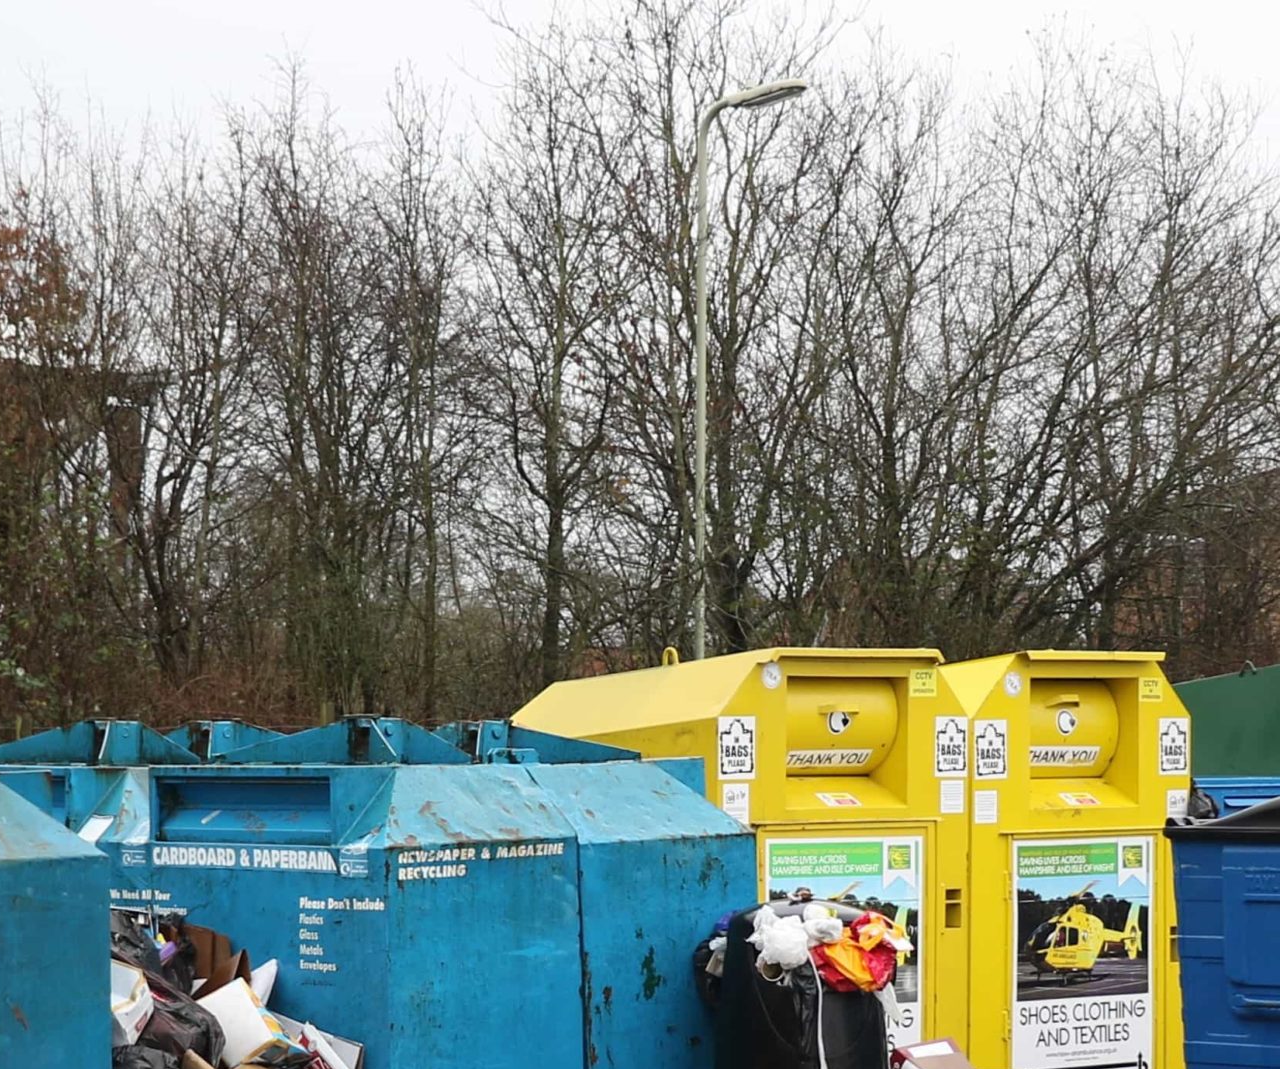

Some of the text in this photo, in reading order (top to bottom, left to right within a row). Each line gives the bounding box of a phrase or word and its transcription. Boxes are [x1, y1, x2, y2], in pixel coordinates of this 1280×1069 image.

[915, 671, 932, 680] CCTV
[725, 745, 749, 758] BAGS
[941, 744, 962, 757] BAGS
[980, 748, 1002, 760] BAGS
[1070, 750, 1097, 762] YOU
[1164, 745, 1183, 757] BAGS
[727, 758, 746, 767] PLEASE
[787, 752, 870, 766] THANK YOU
[942, 757, 960, 765] PLEASE
[982, 760, 999, 769] PLEASE
[1166, 757, 1181, 766] PLEASE
[152, 847, 236, 867] CARDBOARD
[239, 849, 254, 867] &
[480, 847, 491, 860] &
[496, 842, 564, 859] MAGAZINE
[772, 855, 847, 866] SAVING LIVES ACROSS
[1019, 855, 1087, 866] SAVING LIVES ACROSS
[398, 864, 467, 881] RECYCLING
[772, 863, 880, 876] HAMPSHIRE AND ISLE OF WIGHT
[1019, 863, 1114, 876] HAMPSHIRE AND ISLE OF WIGHT
[109, 888, 120, 899] We
[141, 889, 152, 900] All
[154, 889, 171, 901] Your
[299, 896, 385, 911] Please Don't Include
[299, 913, 324, 925] Plastics
[299, 929, 319, 940] Glass
[300, 943, 323, 956] Metals
[300, 959, 337, 974] Envelopes
[1019, 999, 1146, 1026] SHOES, CLOTHING
[1036, 1023, 1130, 1048] AND TEXTILES
